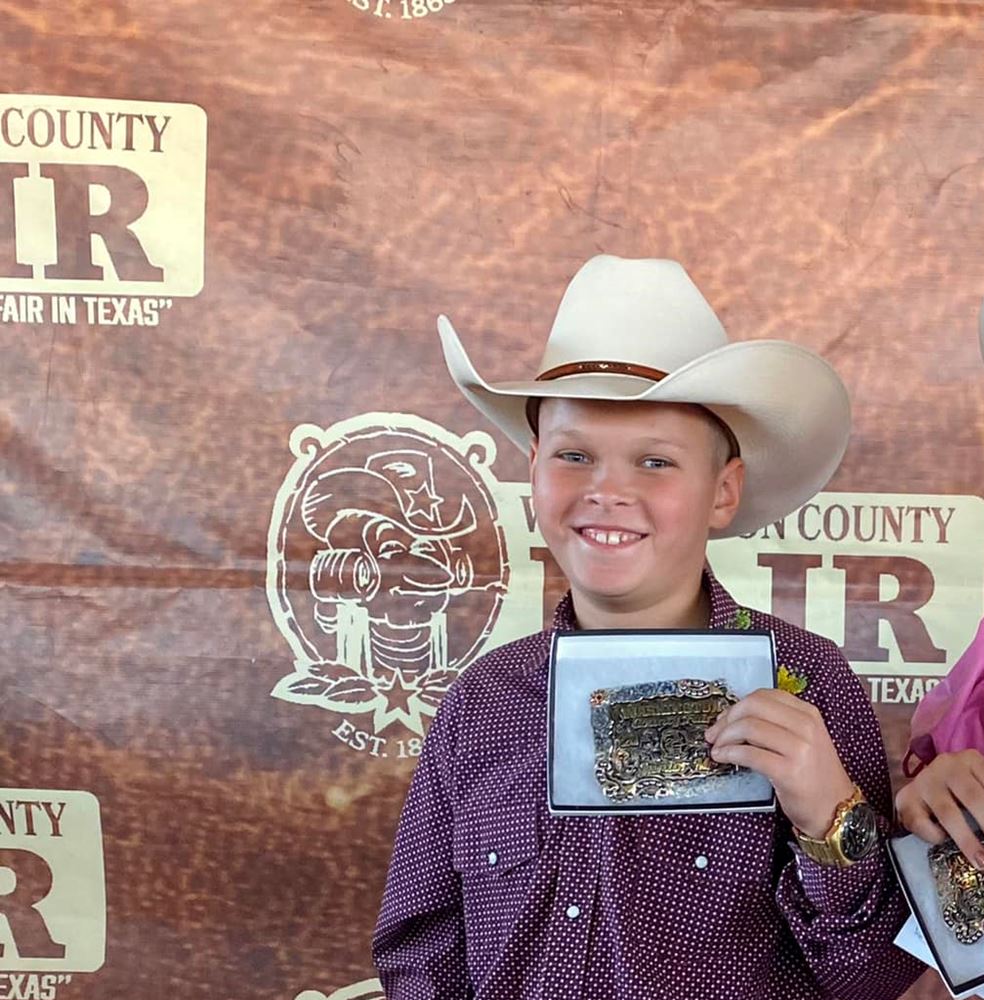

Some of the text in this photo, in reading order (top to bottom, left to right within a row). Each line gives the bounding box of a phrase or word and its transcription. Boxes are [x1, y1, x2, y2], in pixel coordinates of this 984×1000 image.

[1, 107, 171, 153] COUNTY
[0, 294, 44, 324] AIR
[51, 296, 77, 324] IN
[797, 503, 956, 544] COUNTY
[331, 719, 387, 757] EST.
